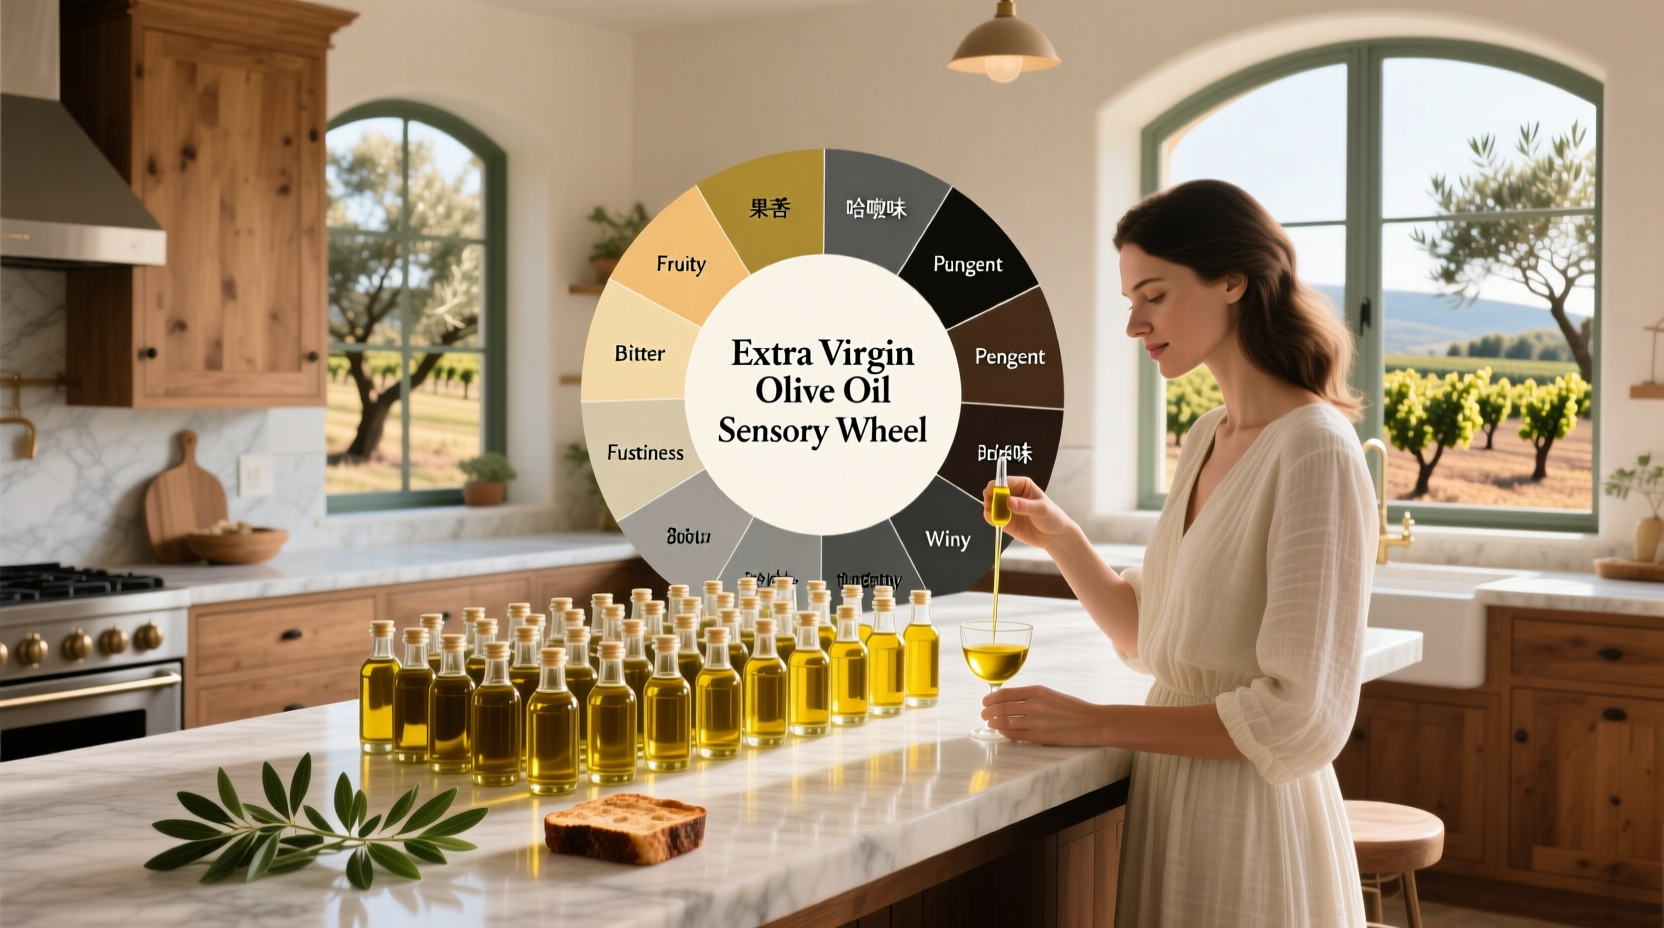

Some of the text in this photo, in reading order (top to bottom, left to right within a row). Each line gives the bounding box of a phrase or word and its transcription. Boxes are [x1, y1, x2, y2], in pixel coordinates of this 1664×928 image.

[657, 254, 707, 277] Fruity
[934, 255, 1004, 277] Pungent
[615, 344, 666, 362] Bitter
[732, 338, 915, 372] Extra Virgin
[975, 347, 1045, 370] Pengent
[755, 375, 891, 404] Olive Oil
[718, 415, 928, 450] Sensory Wheel
[607, 443, 684, 461] Fustiness
[925, 529, 972, 552] Winy
